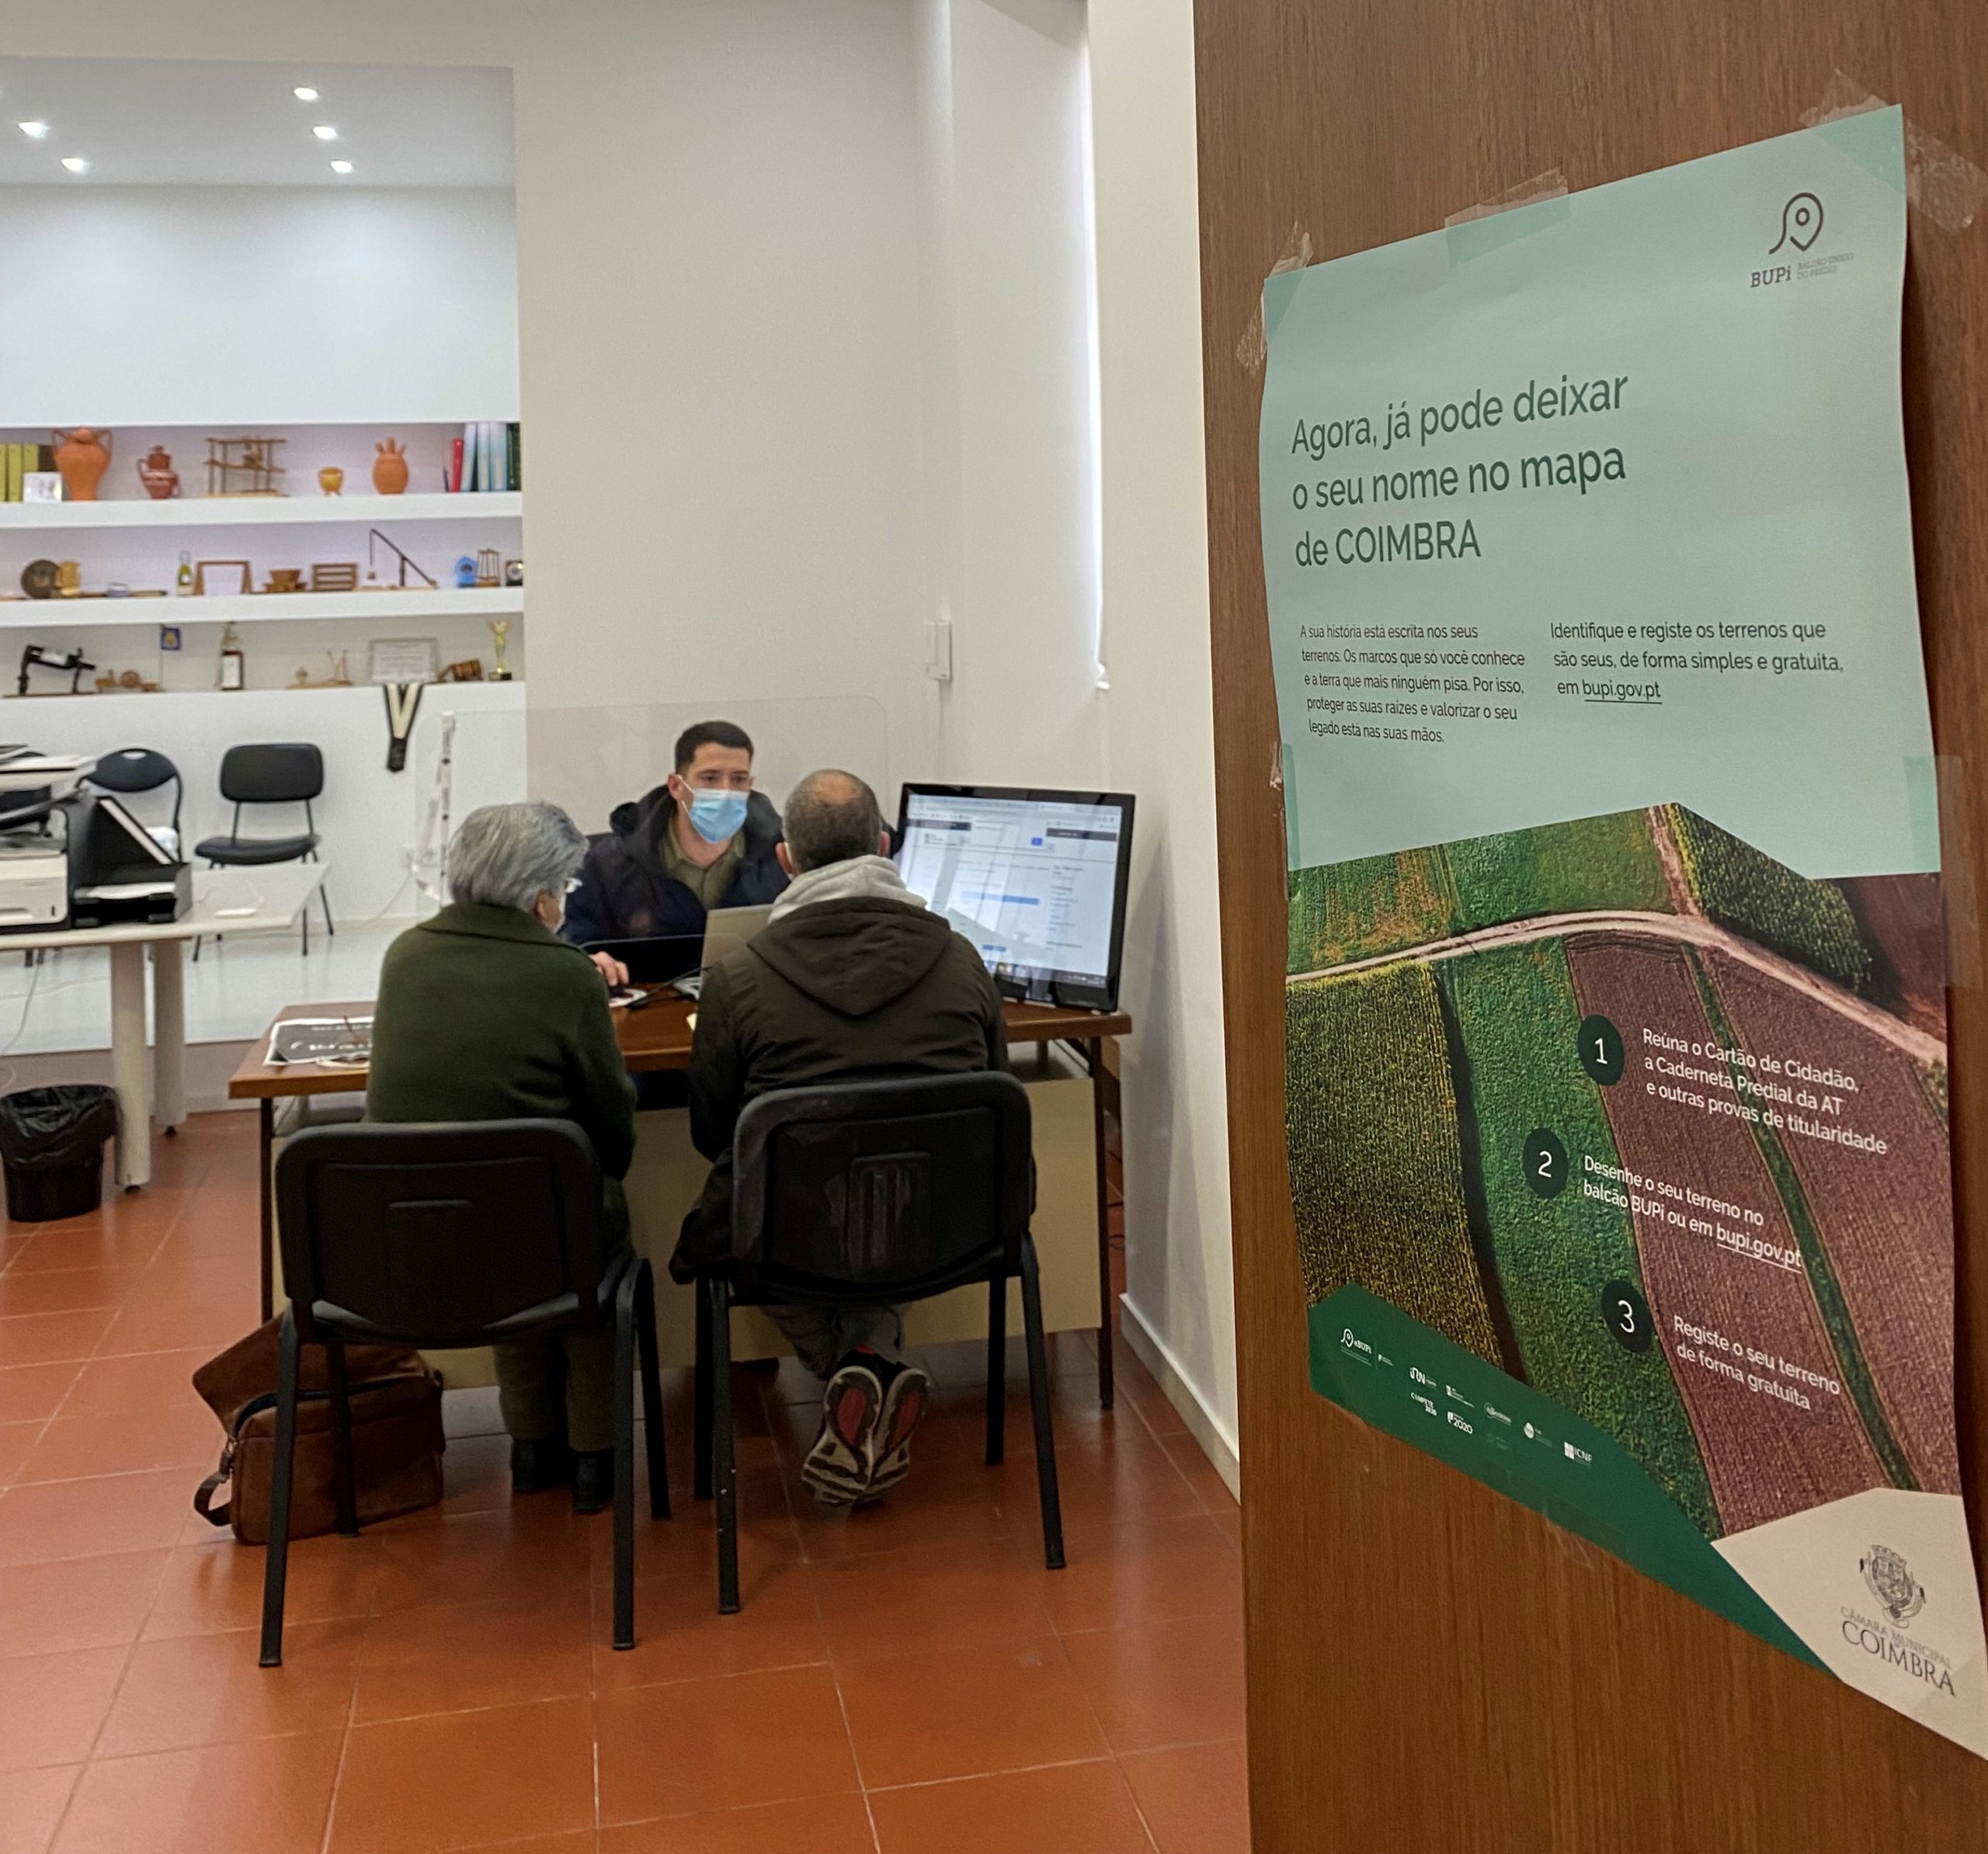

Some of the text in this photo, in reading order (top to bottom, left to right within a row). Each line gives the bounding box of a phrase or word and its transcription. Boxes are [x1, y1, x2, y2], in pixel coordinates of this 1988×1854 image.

[1750, 266, 1791, 288] BUPi
[1291, 374, 1628, 460] Agora, já pode deixar
[1293, 446, 1626, 509] o seu nome no mapa
[1295, 519, 1481, 567] de COIMBRA
[1300, 624, 1478, 638] A sua história está escrita nos seus
[1551, 621, 1826, 642] Identifique e registe os terrenos que
[1343, 650, 1357, 663] Os
[1359, 651, 1397, 664] marcos
[1400, 651, 1421, 667] que
[1424, 650, 1437, 664] só
[1440, 650, 1468, 665] você
[1472, 651, 1525, 665] conhece
[1554, 651, 1844, 674] são seus, de forma simples e gratuita,
[1305, 673, 1524, 694] e a terra que mais ninguém pisa. Por isso,
[1558, 679, 1661, 700] em bupi.gov.pt
[1307, 697, 1517, 720] proteger as suas raízes e valorizar o seu
[1309, 720, 1444, 742] legado está nas suas mãos.
[1594, 1038, 1607, 1064] 1
[1643, 1028, 1688, 1054] Reúna
[1692, 1043, 1701, 1055] o
[1705, 1043, 1756, 1068] Cartão
[1760, 1055, 1781, 1074] de
[1645, 1055, 1844, 1116] a Caderneta Predial da AT
[1646, 1082, 1888, 1154] e outras provas de titularidade
[1538, 1151, 1552, 1178] 2
[1584, 1155, 1764, 1227] Desenhe o seu terreno no
[1583, 1179, 1802, 1267] balcão BUPi ou em bupi.gov.pt
[1618, 1300, 1635, 1333] 3
[1674, 1315, 1840, 1394] Registe o seu terreno
[1677, 1343, 1810, 1411] de forma gratuita
[1454, 1417, 1472, 1434] 2020
[1842, 1620, 1956, 1696] COIMBRA
[1891, 1629, 1953, 1669] MUNICIPAL
